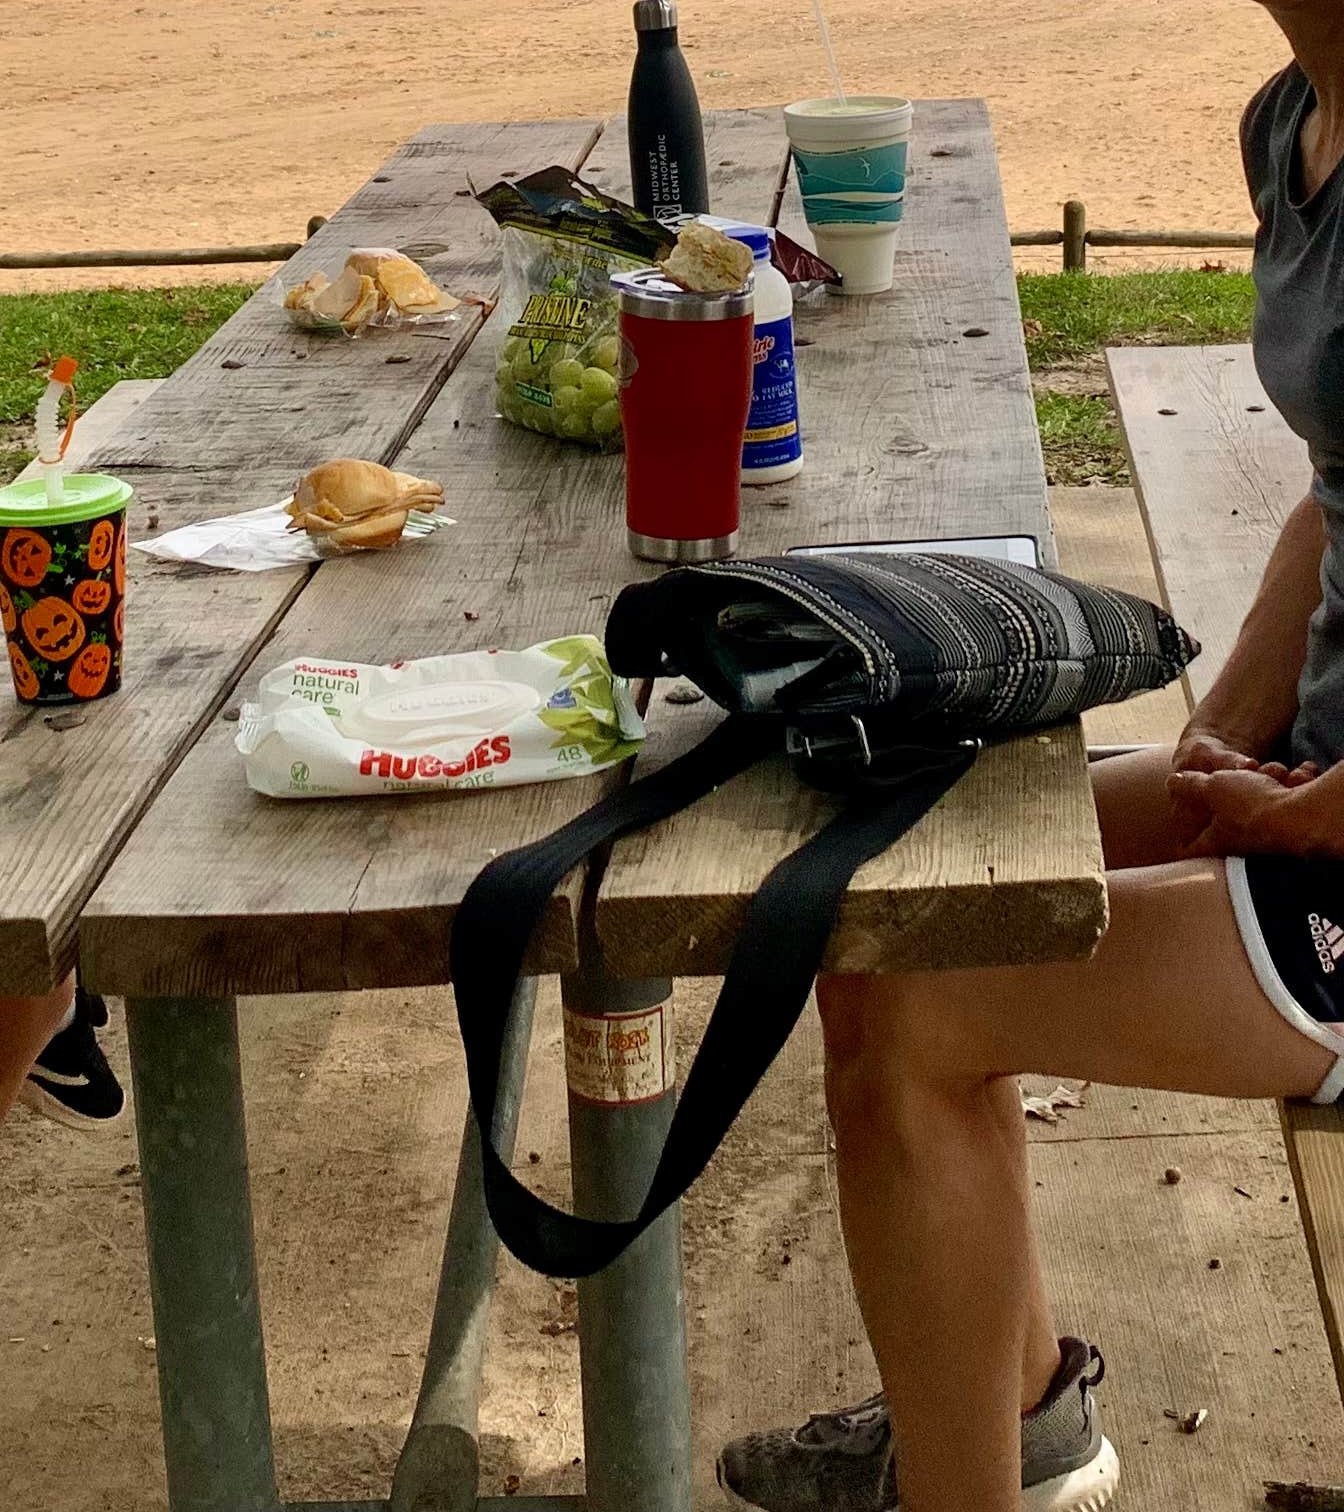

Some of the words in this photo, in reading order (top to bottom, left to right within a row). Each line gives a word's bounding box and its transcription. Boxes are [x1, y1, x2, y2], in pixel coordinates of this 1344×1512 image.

[649, 151, 660, 202] MIDWEST
[670, 161, 680, 201] CENTER
[518, 295, 592, 329] PRISTINE
[293, 674, 359, 696] natural
[557, 746, 582, 762] 48
[1308, 913, 1335, 974] adidas
